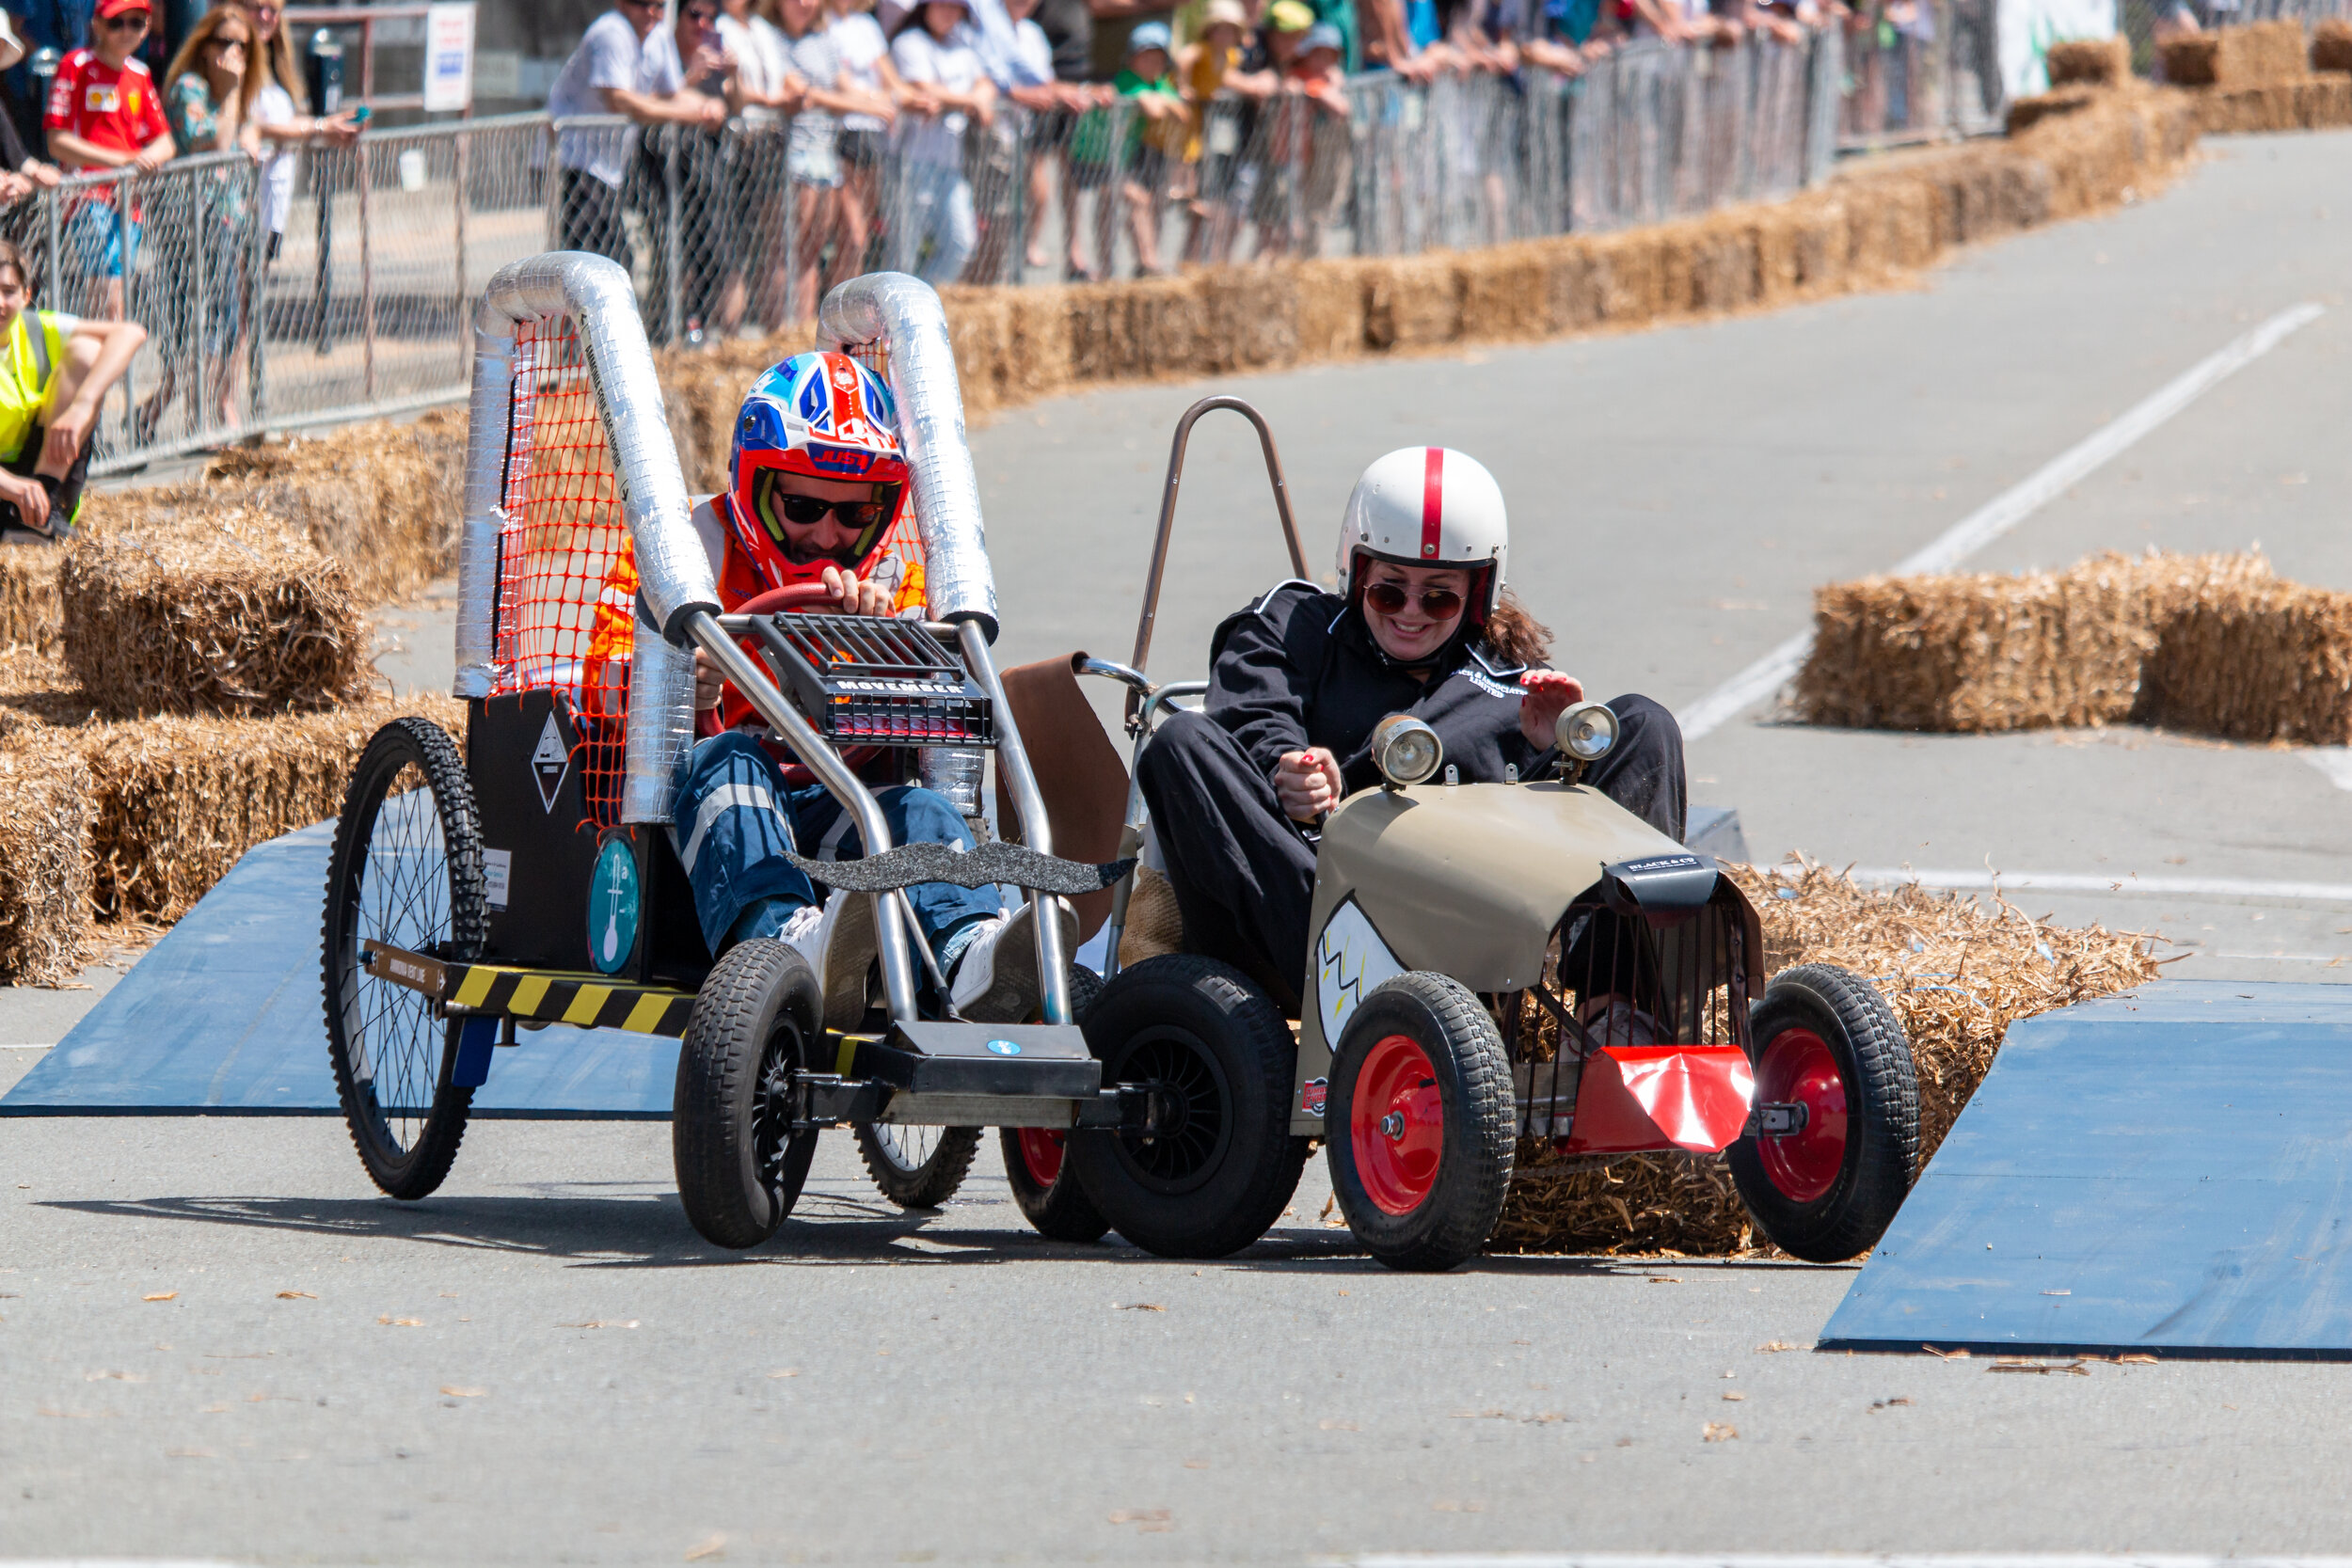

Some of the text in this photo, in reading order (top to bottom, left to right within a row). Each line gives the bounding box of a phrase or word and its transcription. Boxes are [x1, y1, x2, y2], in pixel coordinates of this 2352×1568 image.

[584, 344, 622, 470] AMMONIA FOUL GAS VAPOUR
[836, 680, 963, 694] MOVEMBER
[1469, 675, 1504, 699] LIMITED
[1628, 860, 1671, 870] BLACK
